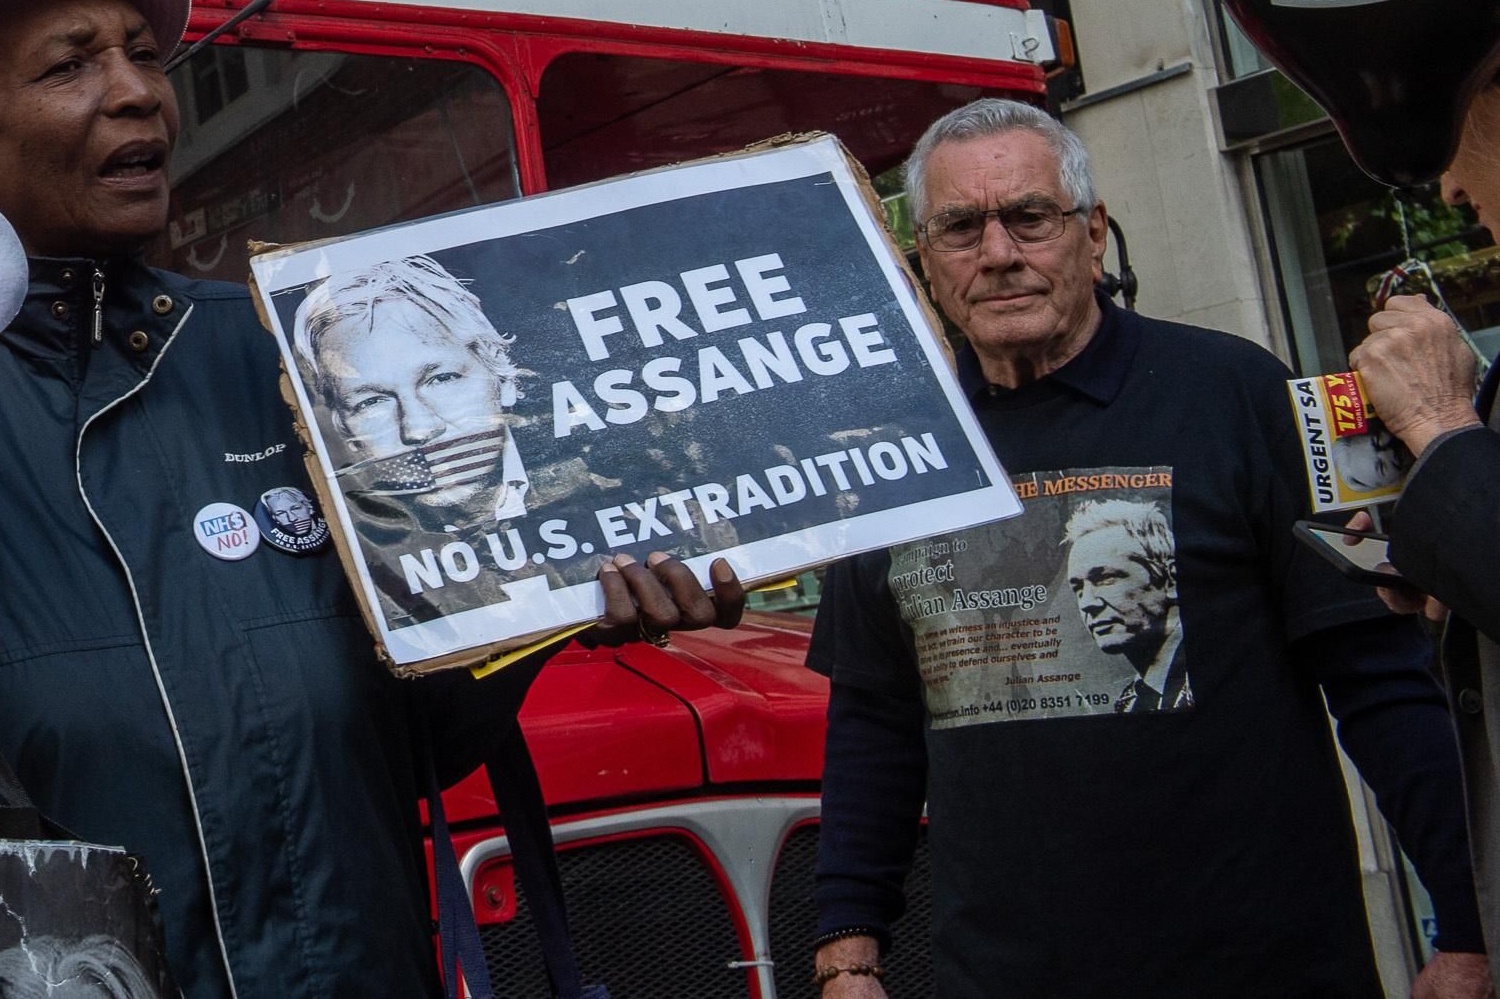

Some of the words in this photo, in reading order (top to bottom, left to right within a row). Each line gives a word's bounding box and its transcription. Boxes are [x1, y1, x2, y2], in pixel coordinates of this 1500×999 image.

[566, 252, 807, 362] FREE
[550, 312, 897, 439] ASSANGE
[1331, 394, 1357, 432] 175
[224, 443, 287, 463] DUNLOP
[1303, 414, 1334, 504] URGENT
[1012, 480, 1039, 499] HE
[1043, 473, 1173, 497] MESSENGER
[399, 539, 481, 595] NO
[491, 516, 593, 572] U.S.
[594, 432, 948, 548] EXTRADITION
[217, 530, 249, 551] NO!
[271, 527, 296, 544] FREE
[952, 539, 968, 553] to
[951, 584, 1047, 612] Assange
[948, 624, 982, 634] witness
[999, 617, 1040, 629] injustice
[1042, 615, 1061, 624] and
[947, 635, 965, 645] train
[967, 635, 983, 643] our
[985, 630, 1031, 641] character
[1033, 629, 1042, 637] to
[1046, 627, 1058, 636] be
[1011, 637, 1062, 651] eventually
[959, 656, 989, 667] defend
[991, 652, 1037, 663] ourselves
[1039, 649, 1059, 659] and
[1005, 676, 1034, 686] Julian
[1037, 672, 1081, 683] Assange
[983, 701, 1003, 713] +44
[1006, 698, 1037, 715] (0)20
[1040, 695, 1071, 709] 8351
[1075, 693, 1110, 707] 7199
